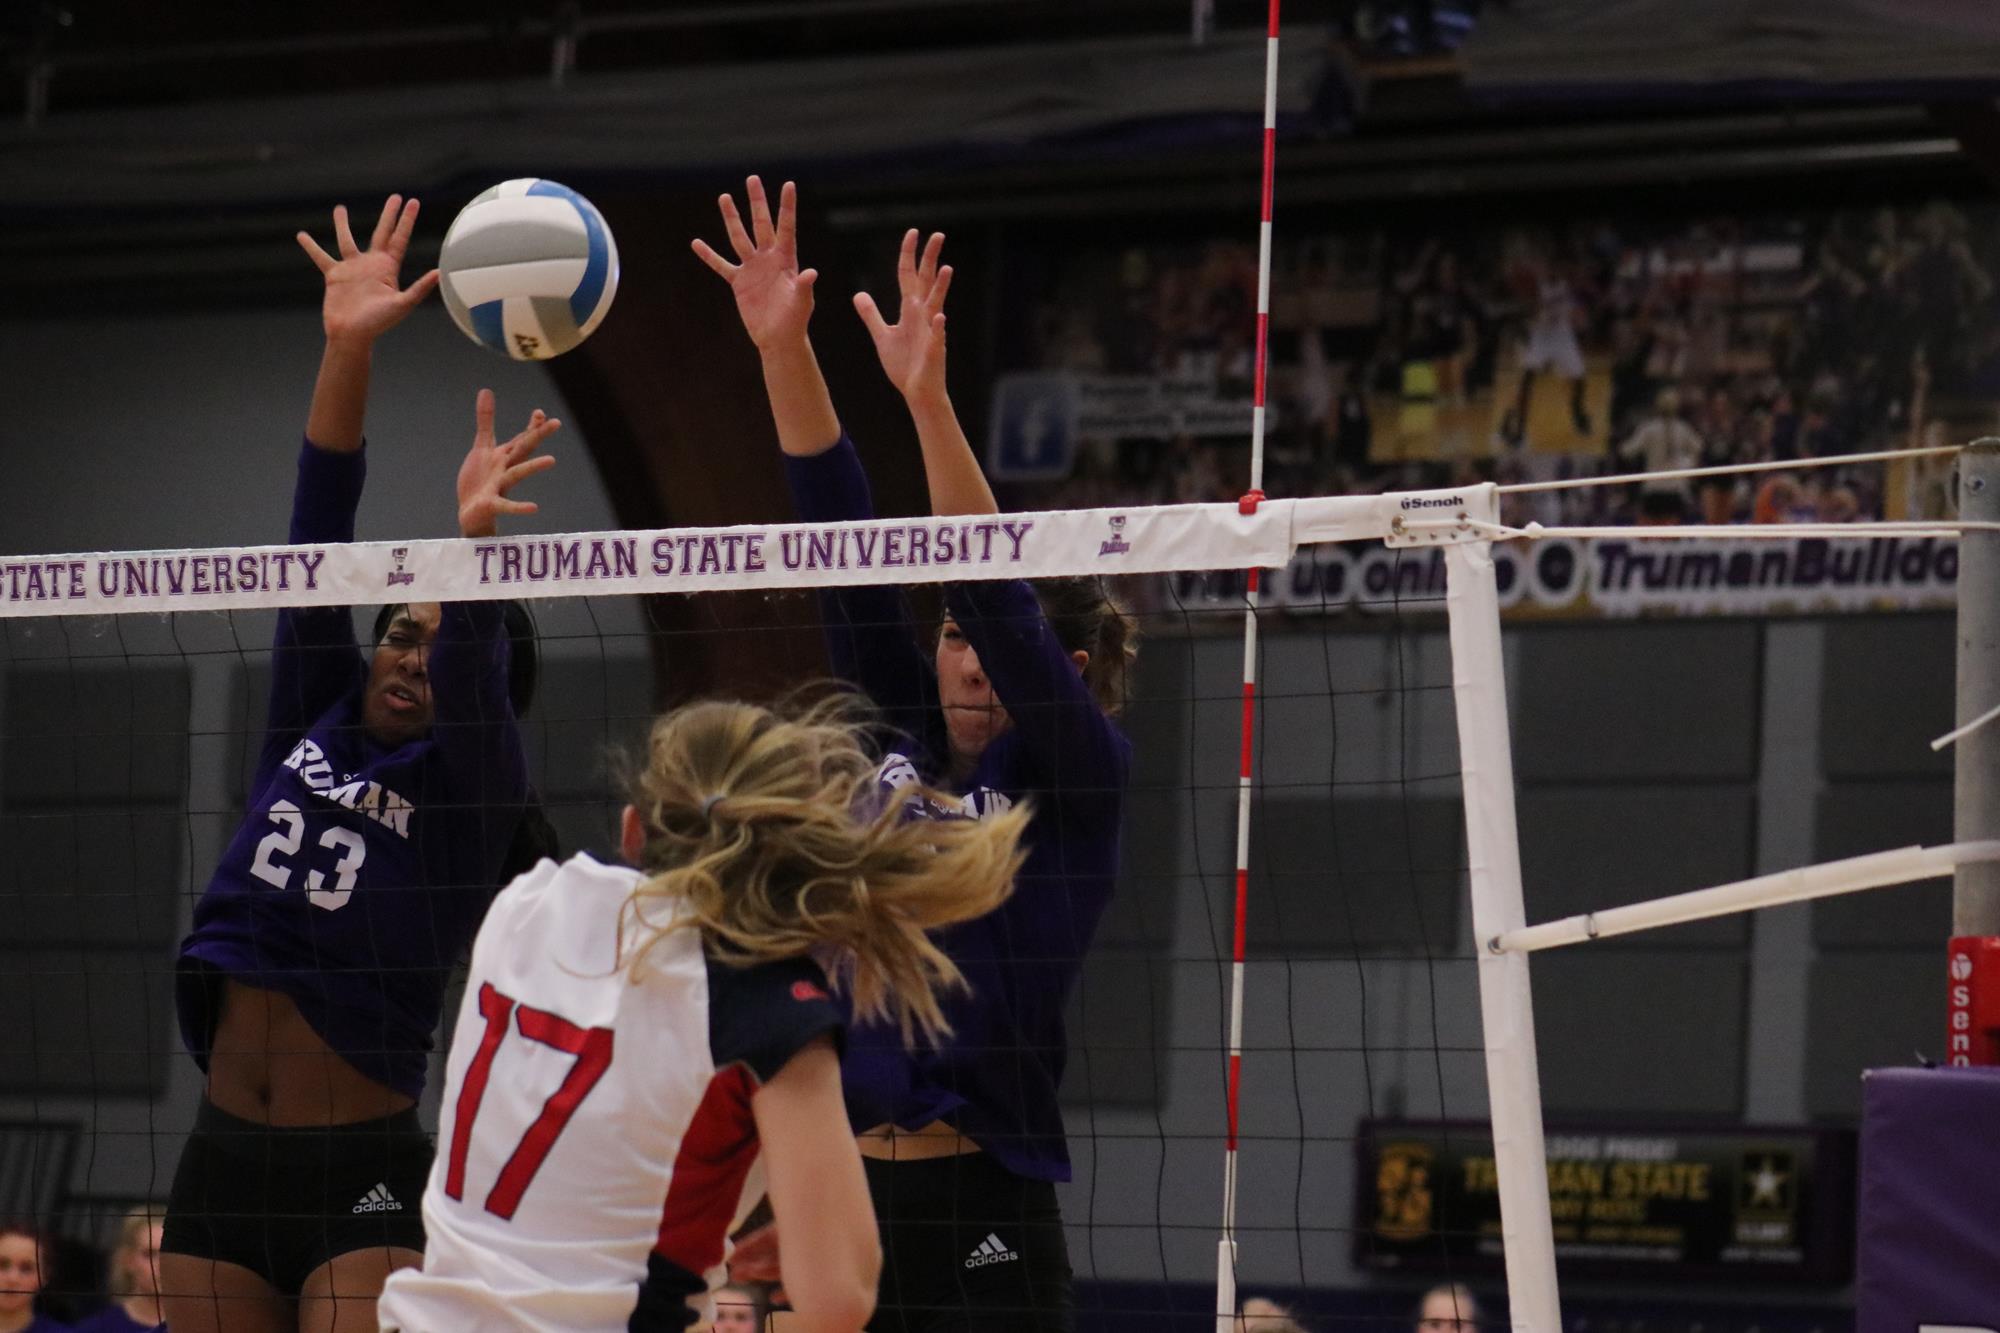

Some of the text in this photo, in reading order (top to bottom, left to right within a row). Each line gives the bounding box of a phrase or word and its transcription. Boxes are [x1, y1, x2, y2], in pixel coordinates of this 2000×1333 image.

[1412, 496, 1464, 509] Senoh
[0, 520, 1033, 602] TATE UNIVERSITY TRUMAN STATE UNIVERSITY
[250, 799, 366, 911] 23
[444, 980, 614, 1222] 17
[352, 1201, 403, 1214] adidas
[965, 1251, 1018, 1268] adidas
